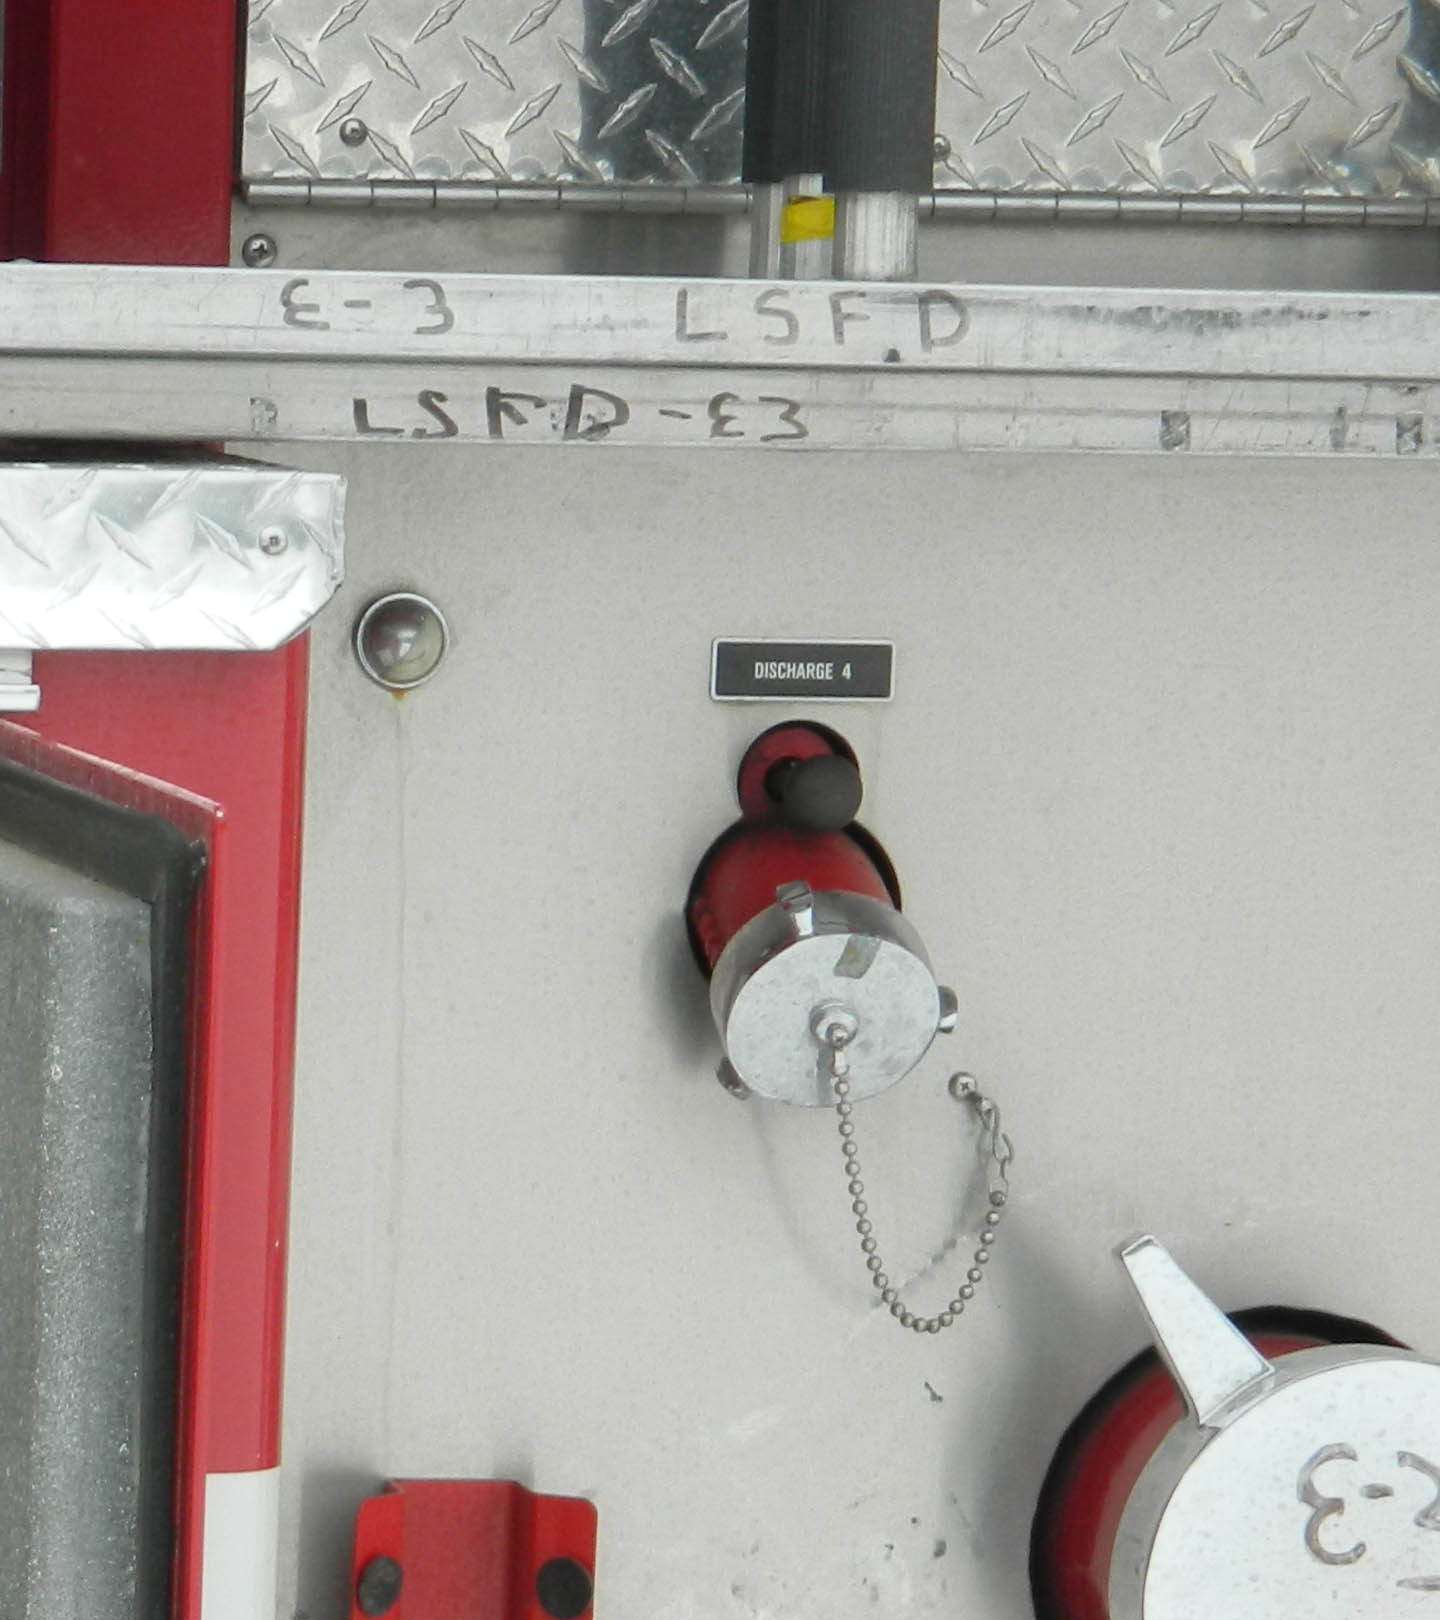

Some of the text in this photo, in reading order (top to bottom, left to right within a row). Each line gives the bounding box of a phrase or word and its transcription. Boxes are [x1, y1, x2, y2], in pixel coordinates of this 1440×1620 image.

[675, 286, 970, 351] LSFD
[754, 661, 852, 680] DISCHARGE 4
